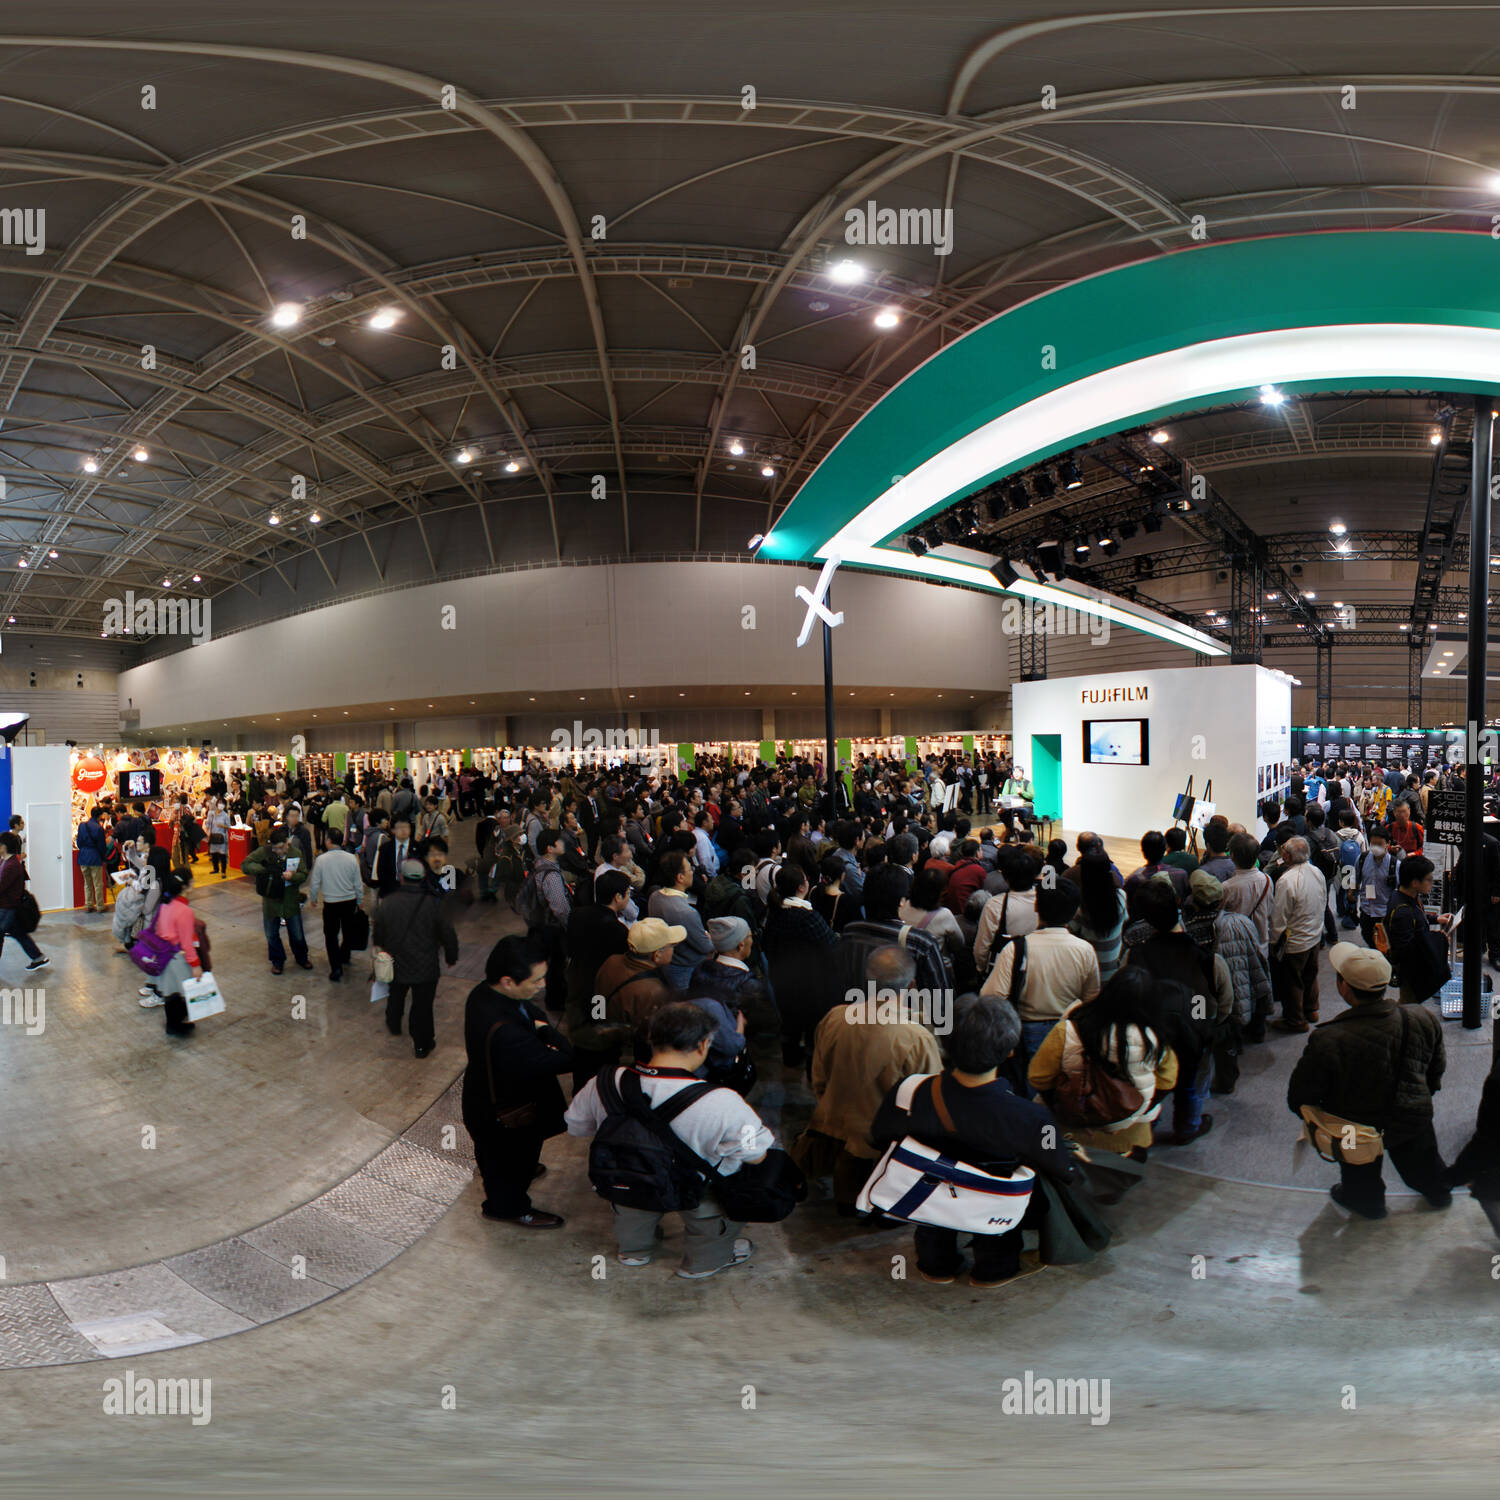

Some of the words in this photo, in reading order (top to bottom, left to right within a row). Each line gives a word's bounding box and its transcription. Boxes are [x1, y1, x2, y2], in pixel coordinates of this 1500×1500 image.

[1081, 686, 1149, 704] FUJIFILM
[1438, 832, 1463, 843] こちら
